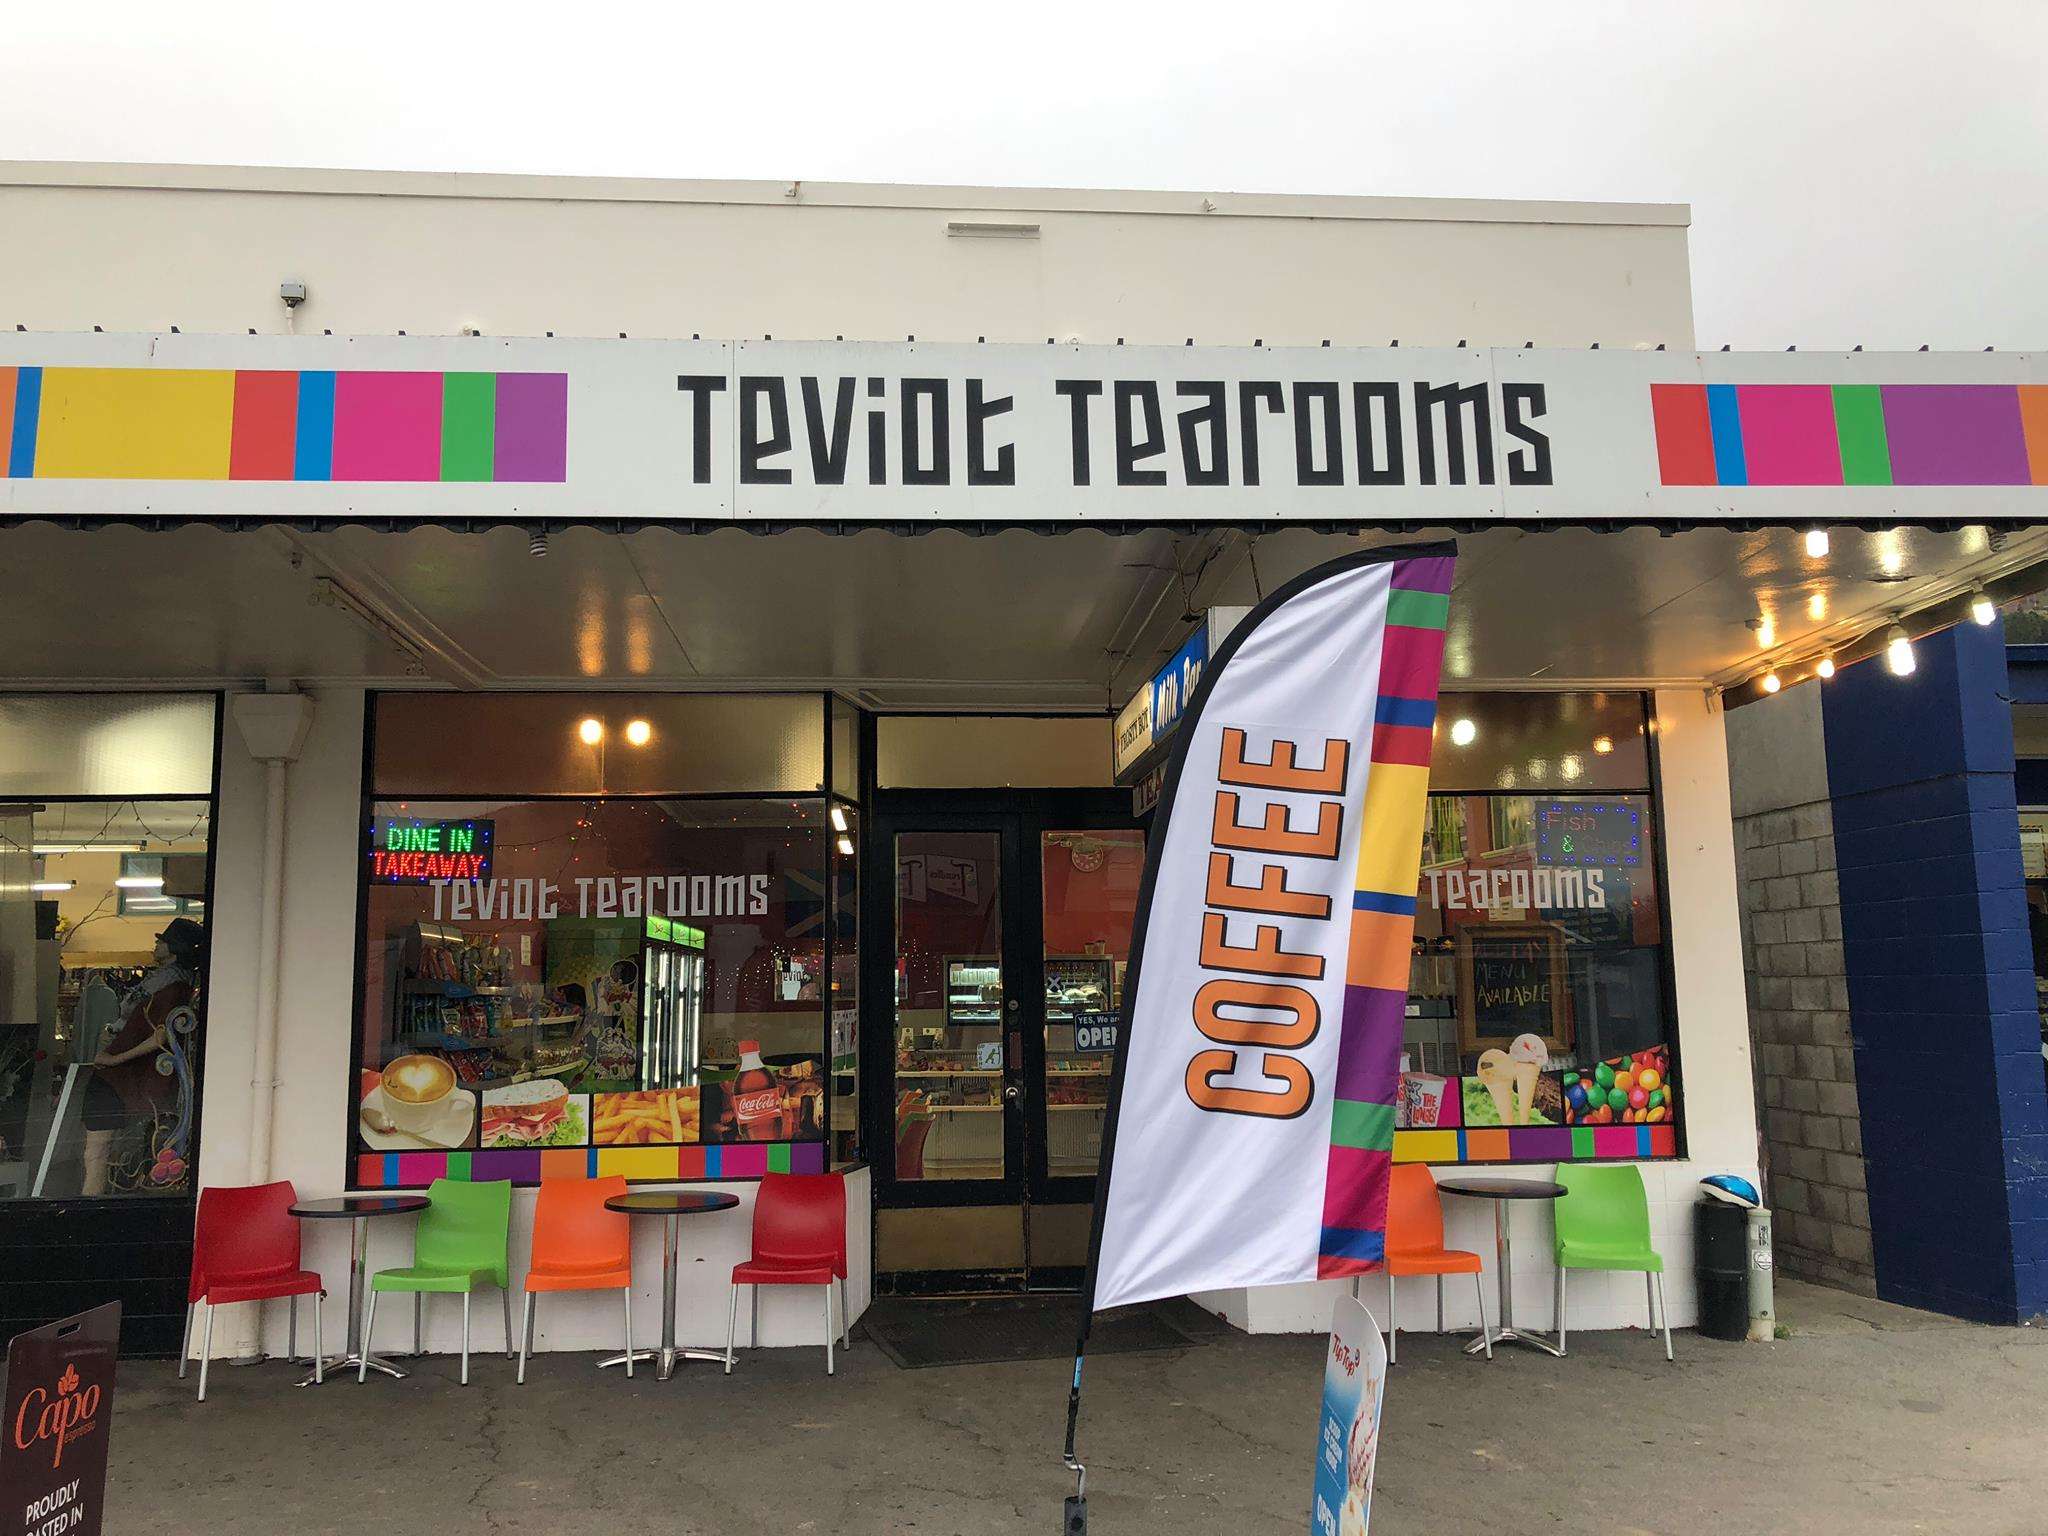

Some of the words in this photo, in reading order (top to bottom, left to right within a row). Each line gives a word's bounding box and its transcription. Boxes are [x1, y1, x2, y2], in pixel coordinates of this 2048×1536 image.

[677, 376, 1015, 486] Teviot
[1055, 379, 1553, 486] Tearooms
[1156, 669, 1178, 732] Milk
[1182, 656, 1202, 709] Bar
[387, 828, 440, 851] DINE
[450, 829, 473, 852] IN
[1546, 811, 1596, 831] Fish
[374, 851, 484, 877] TAKEAWAY
[1560, 834, 1576, 852] &
[429, 878, 558, 920] Teviot
[575, 875, 769, 919] Tearooms
[1425, 869, 1606, 909] Tearooms
[1184, 726, 1351, 1120] COFFEE
[15, 1384, 100, 1468] Capo
[25, 1478, 80, 1525] PROUDLY
[70, 1502, 84, 1527] IN
